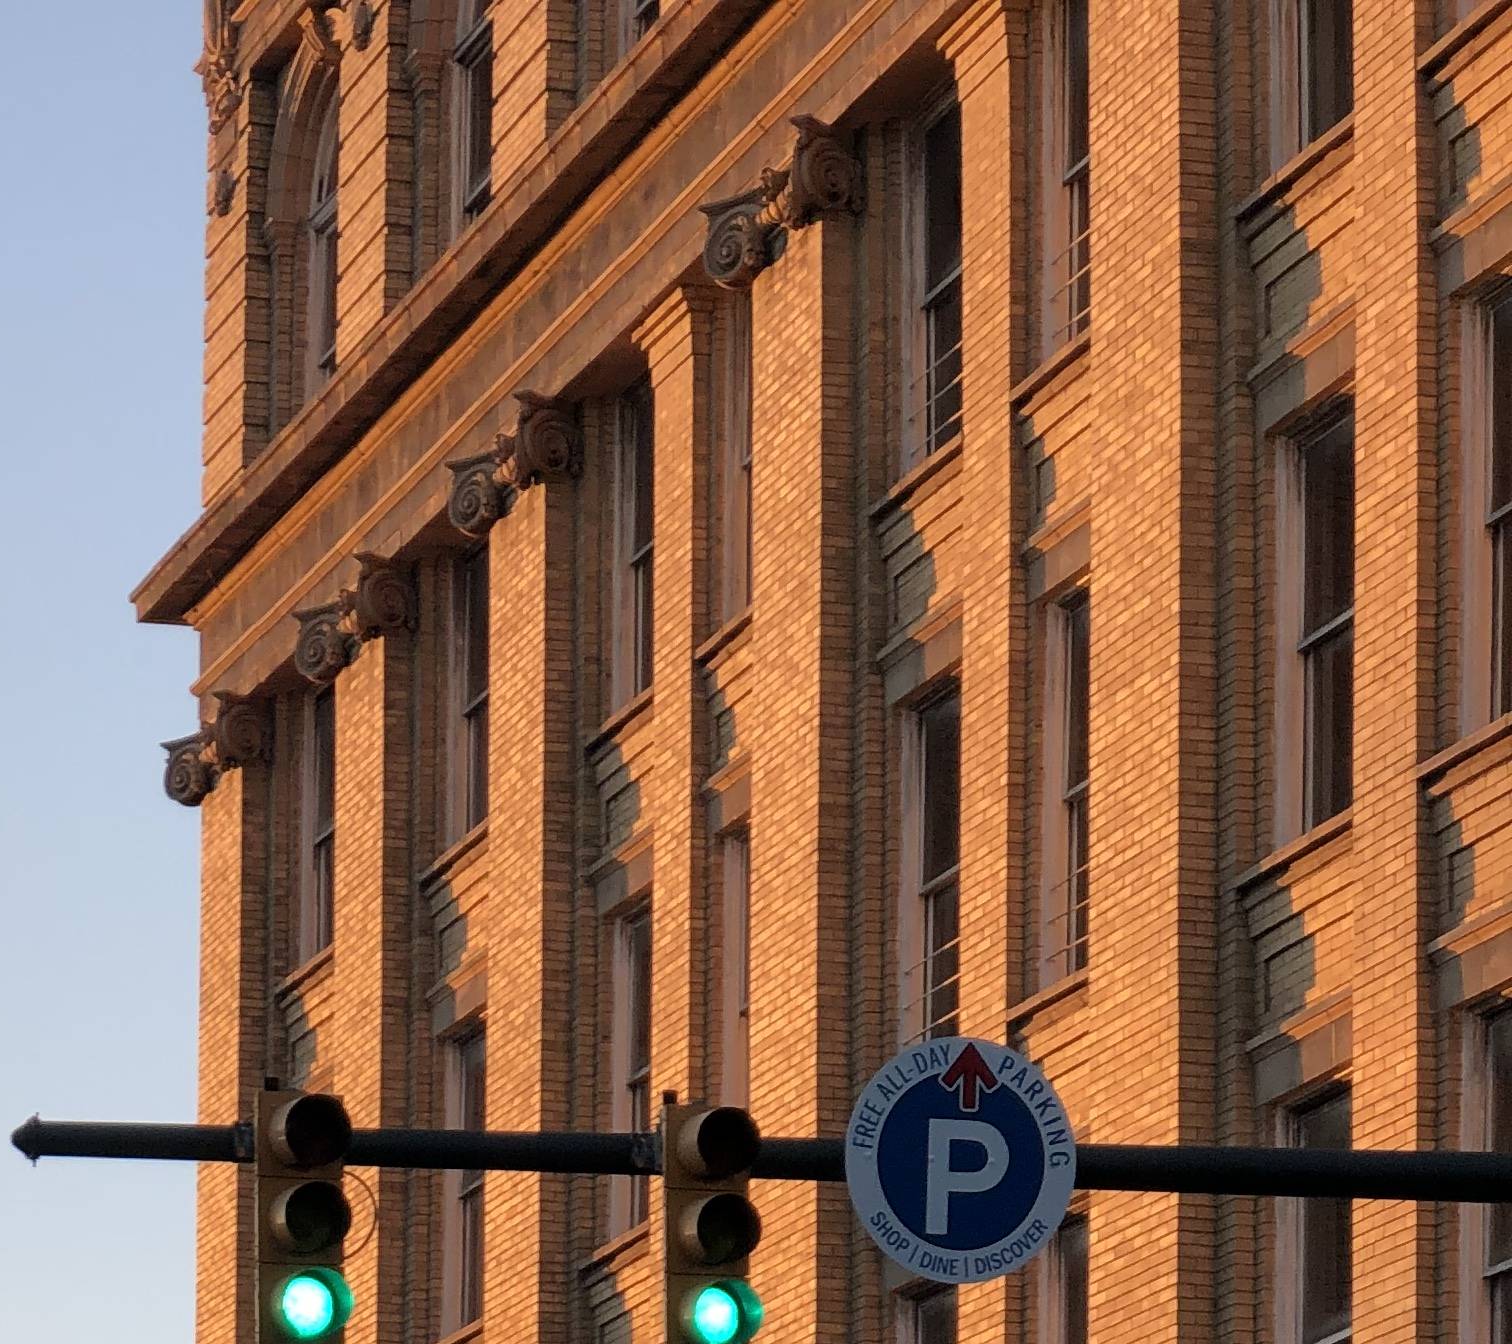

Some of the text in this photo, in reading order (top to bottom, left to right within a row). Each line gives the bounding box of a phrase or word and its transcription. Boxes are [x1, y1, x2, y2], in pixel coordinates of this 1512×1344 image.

[853, 1044, 1071, 1169] FREE ALL-DAY PARKING
[925, 1118, 1009, 1235] P
[870, 1210, 1049, 1277] SHOP DINE DISCOVER
